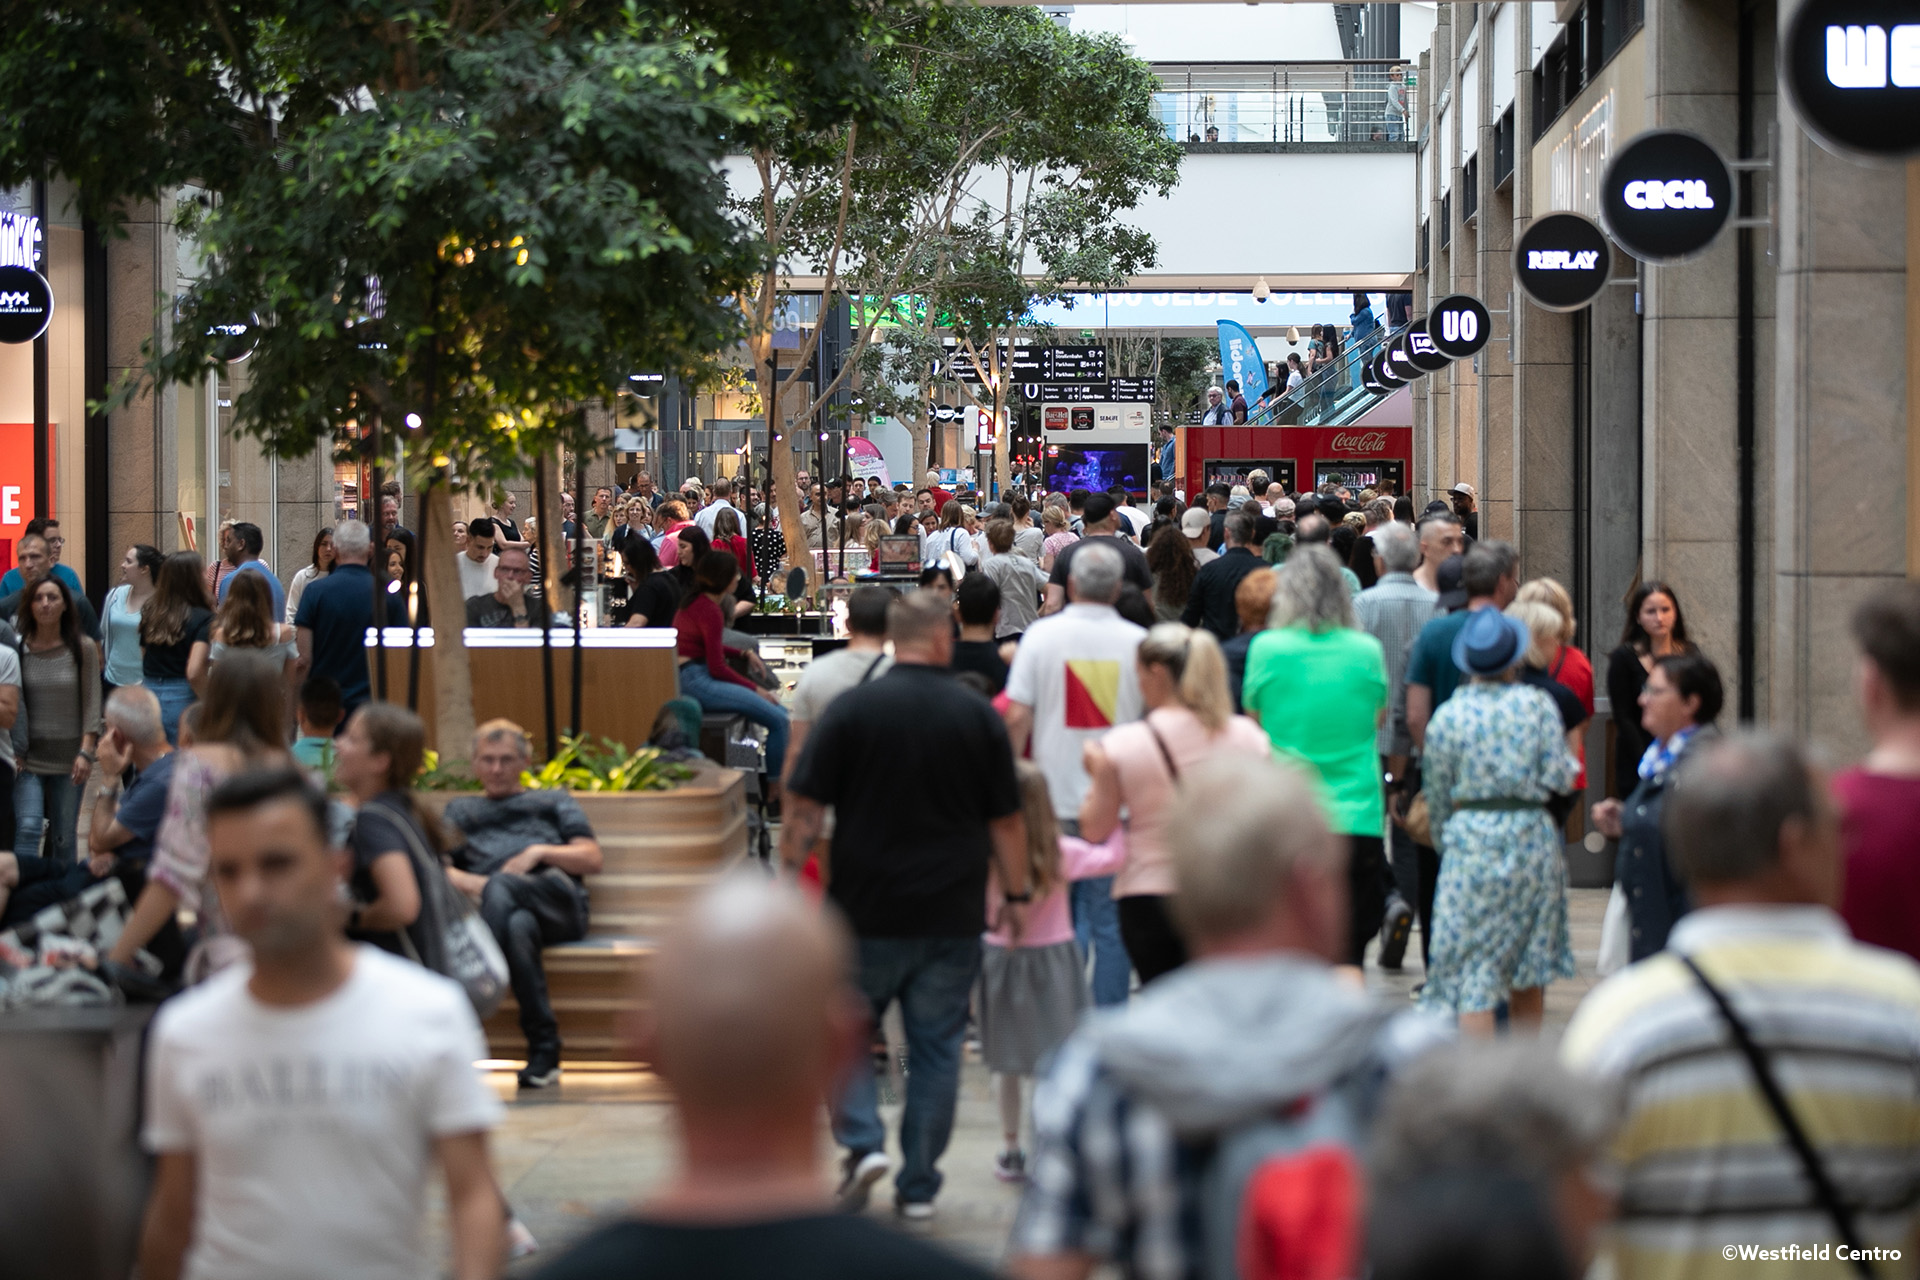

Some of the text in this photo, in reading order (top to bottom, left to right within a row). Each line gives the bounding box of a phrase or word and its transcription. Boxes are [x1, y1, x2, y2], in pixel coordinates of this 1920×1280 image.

[1623, 179, 1715, 210] CECIL
[1527, 250, 1599, 270] REPLAY
[1443, 309, 1478, 342] UO
[1331, 431, 1389, 452] Coca-Cola
